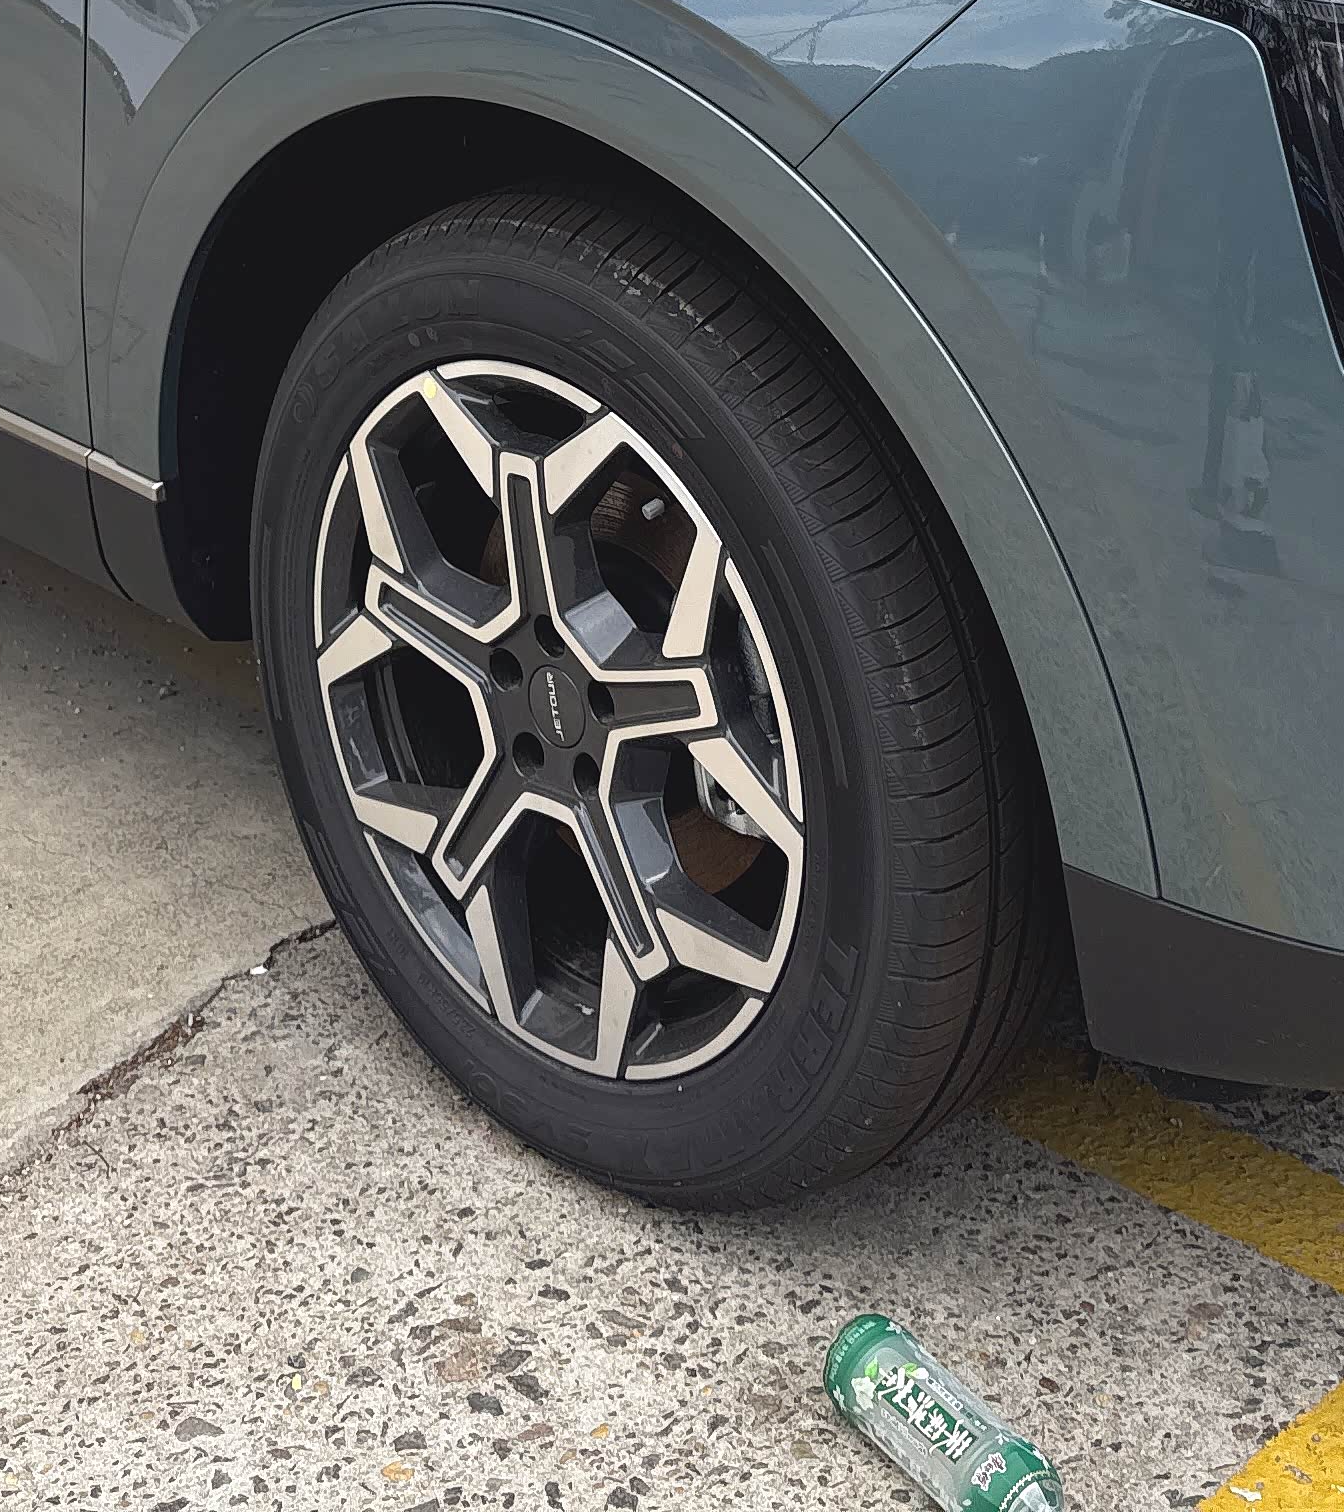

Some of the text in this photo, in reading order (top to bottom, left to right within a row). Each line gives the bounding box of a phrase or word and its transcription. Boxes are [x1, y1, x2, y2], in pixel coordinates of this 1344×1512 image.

[545, 671, 566, 742] JETOUR
[878, 1365, 976, 1460] 茉莉清茶
